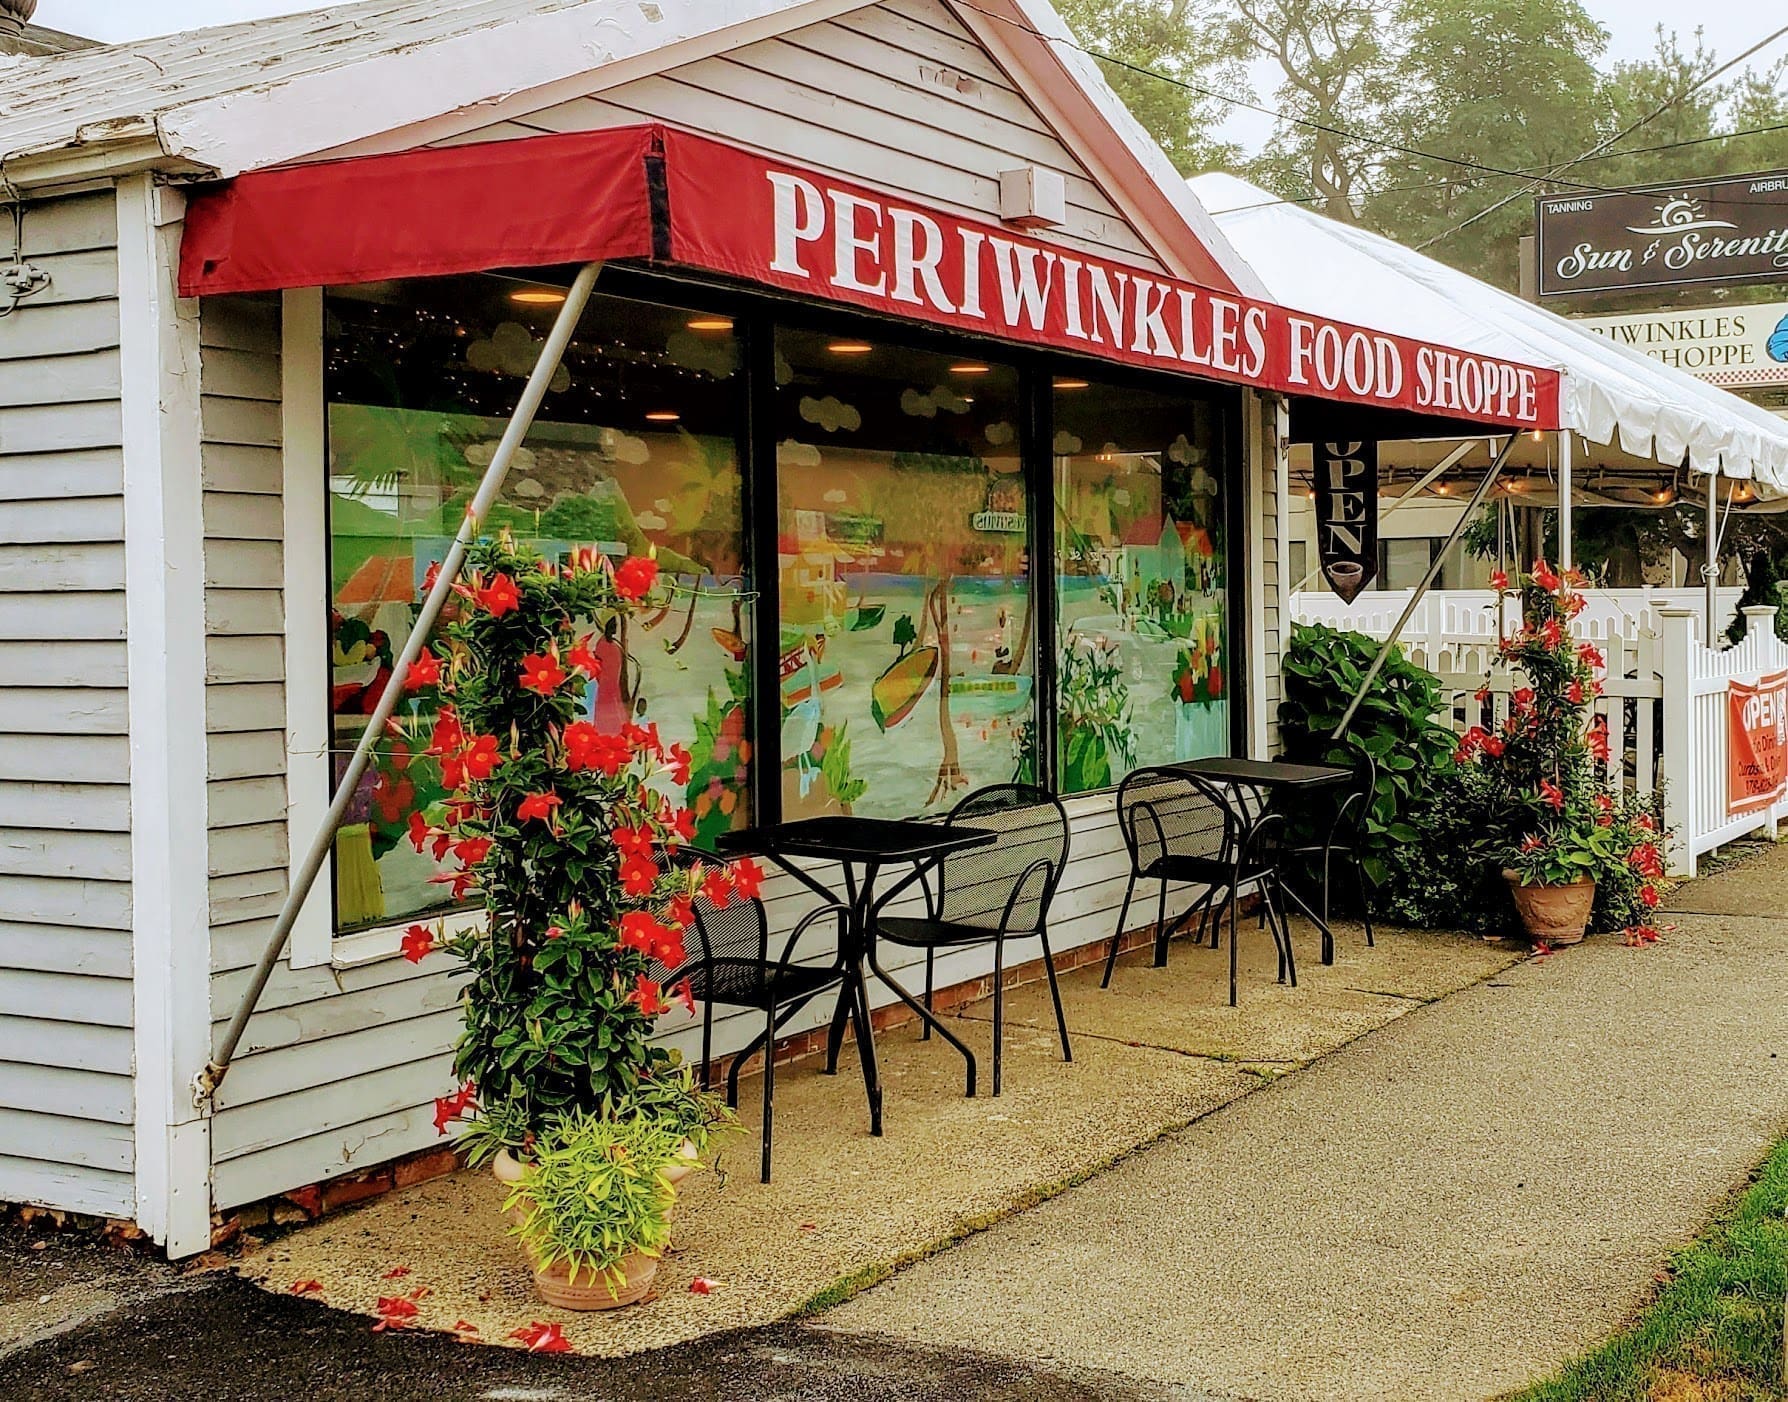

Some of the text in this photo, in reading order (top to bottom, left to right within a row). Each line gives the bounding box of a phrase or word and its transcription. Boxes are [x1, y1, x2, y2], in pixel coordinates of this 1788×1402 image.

[1547, 200, 1593, 214] TANNING
[1556, 242, 1632, 279] Sun
[767, 170, 1537, 421] PERIWINKLES FOOD SHOPPE
